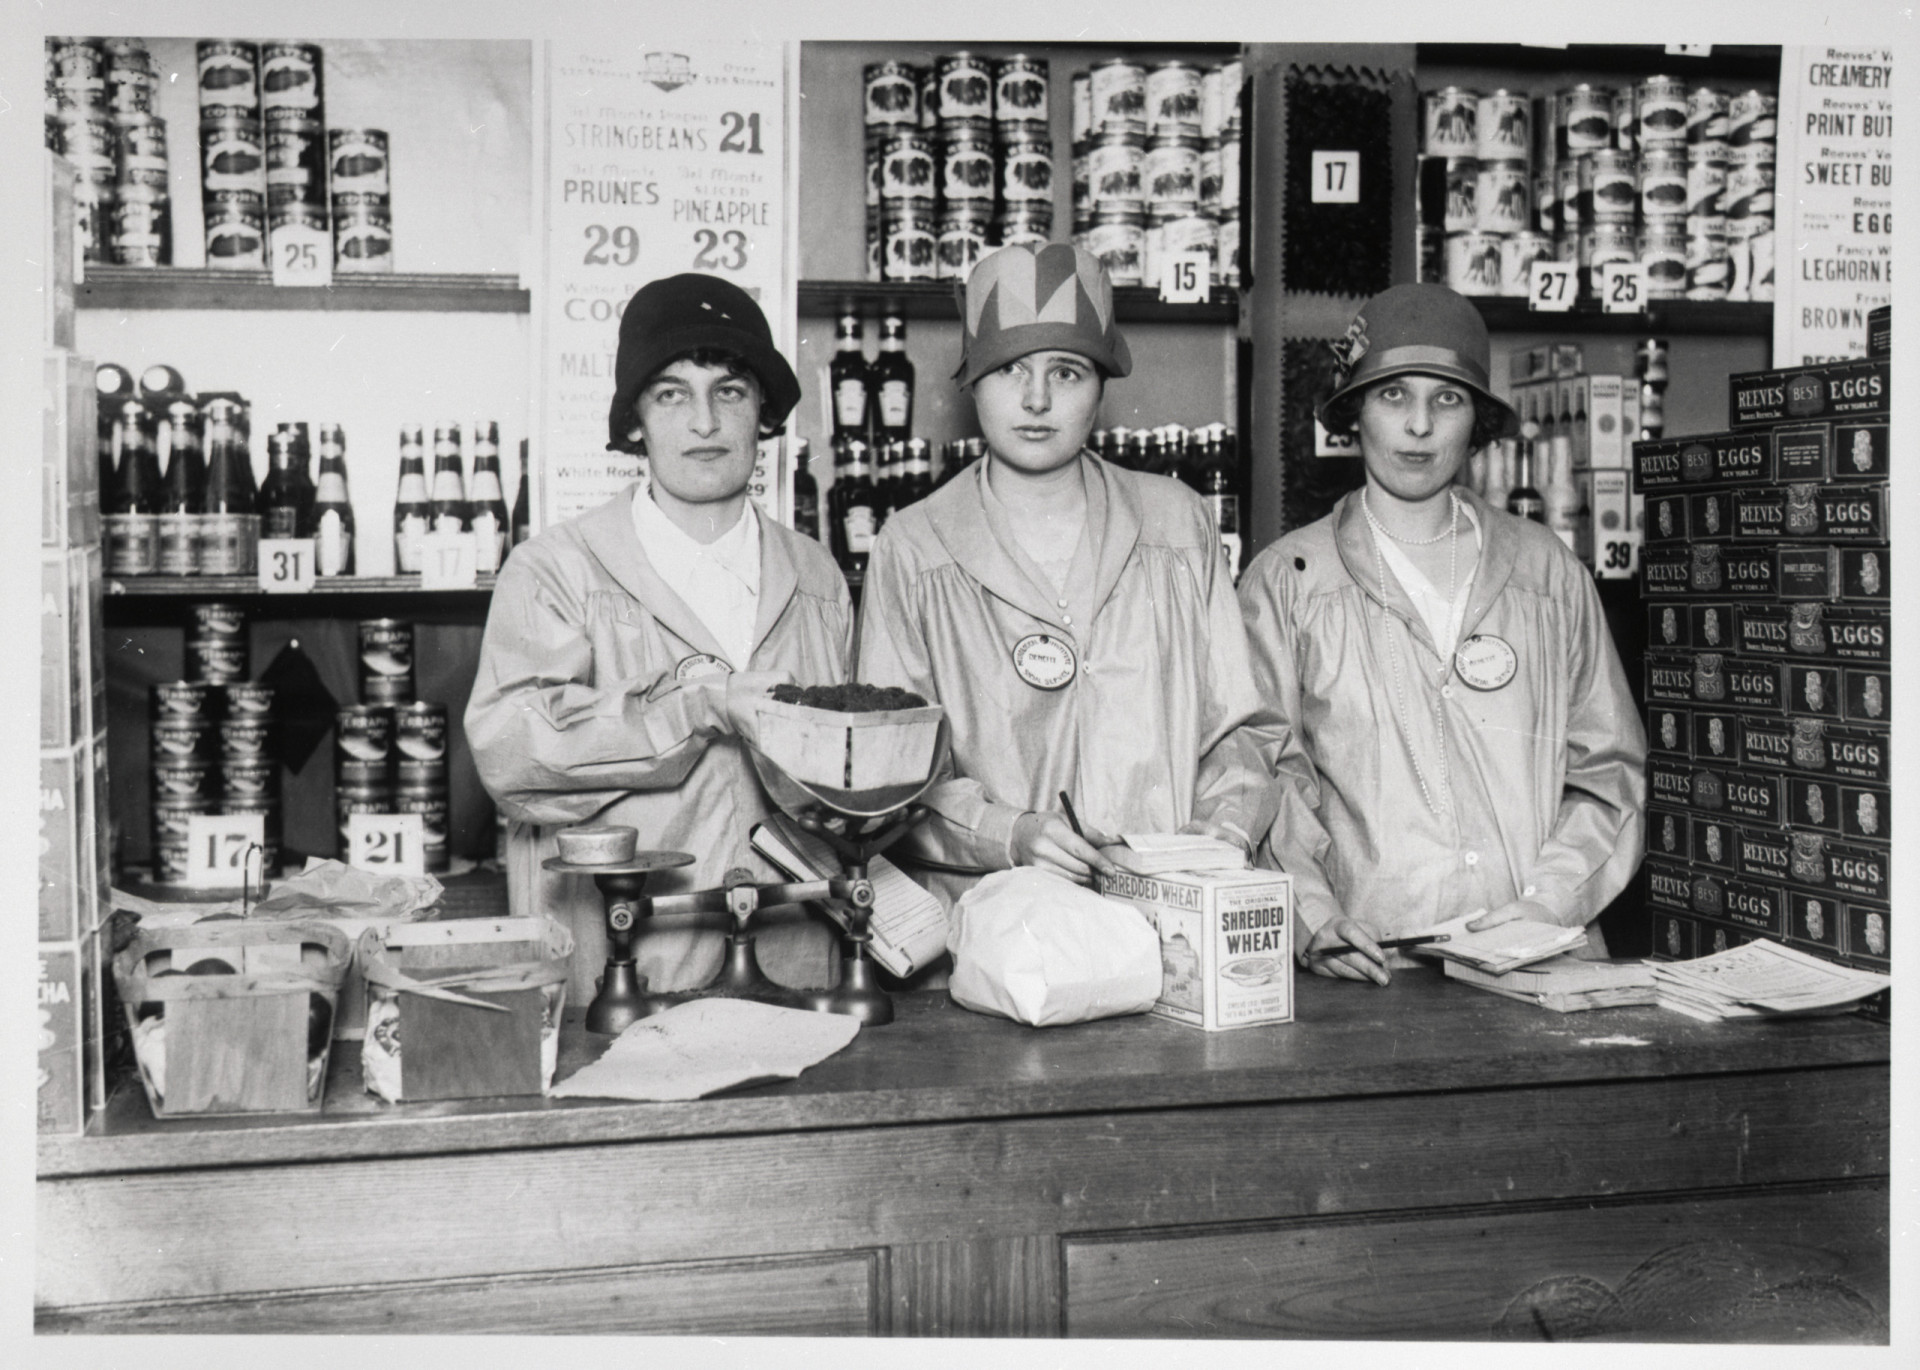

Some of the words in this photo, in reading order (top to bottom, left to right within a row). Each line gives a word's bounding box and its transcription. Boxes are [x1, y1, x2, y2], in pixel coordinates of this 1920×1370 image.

[1882, 51, 1893, 61] V
[1809, 64, 1892, 88] CREAMERY
[565, 123, 708, 151] STRINGBEANS
[719, 111, 764, 155] 21
[1806, 113, 1855, 136] PRINT
[711, 168, 763, 184] Monte
[1324, 162, 1347, 192] 17
[1805, 163, 1862, 185] SWEET
[1871, 165, 1892, 186] BU
[564, 180, 660, 205] PRUNES
[695, 185, 750, 197] SLICED
[673, 199, 769, 226] PINEAPPLE
[285, 243, 317, 270] 25
[583, 224, 640, 266] 29
[693, 228, 748, 270] 23
[1837, 244, 1872, 256] Fancy
[1173, 262, 1196, 290] 15
[1802, 259, 1880, 282] LEGHORN
[1541, 272, 1567, 301] 27
[1613, 274, 1637, 302] 25
[1802, 307, 1863, 329] BROWN
[560, 353, 616, 377] MALT
[1738, 383, 1785, 408] REEVES'
[1793, 384, 1819, 400] BEST
[1830, 375, 1882, 400] EGGS
[606, 465, 646, 478] Rock
[1640, 452, 1680, 474] REEVES'
[1686, 453, 1711, 468] BEST
[1718, 446, 1762, 468] EGGS
[1740, 502, 1783, 522] REEVES'
[1790, 514, 1813, 527] BEST
[1824, 502, 1872, 522] EGGS
[272, 551, 300, 581] 31
[1605, 541, 1631, 569] 39
[1647, 561, 1688, 580] REEVES'
[1695, 571, 1717, 584] BEST
[1727, 562, 1770, 580] EGGS
[1744, 620, 1788, 640] REEVES'
[1795, 632, 1820, 646] BEST
[1830, 624, 1884, 646] EGGS
[1652, 668, 1692, 688] REEVES'
[1699, 680, 1721, 694] BEST
[1730, 673, 1774, 694] EGGS
[1746, 731, 1790, 754] REEVES'
[1796, 748, 1820, 762] BEST
[1832, 742, 1880, 765] EGGS
[1836, 766, 1849, 774] NEW
[1654, 772, 1692, 794] REEVES'
[1698, 780, 1718, 794] BEST
[1728, 783, 1770, 806] EGGS
[206, 833, 247, 868] 17
[364, 831, 404, 863] 21
[1744, 842, 1789, 866] REEVES'
[1796, 862, 1820, 876] BEST
[1831, 858, 1879, 883] EGGS
[1105, 875, 1159, 901] SHREDDED
[1161, 883, 1200, 909] WHEAT
[1245, 895, 1278, 905] ORIGINAL
[1651, 874, 1691, 898] REEVES'
[1698, 886, 1718, 901] BEST
[1728, 892, 1771, 916] EGGS
[1222, 906, 1284, 932] SHREDDED
[1227, 930, 1281, 955] WHEAT
